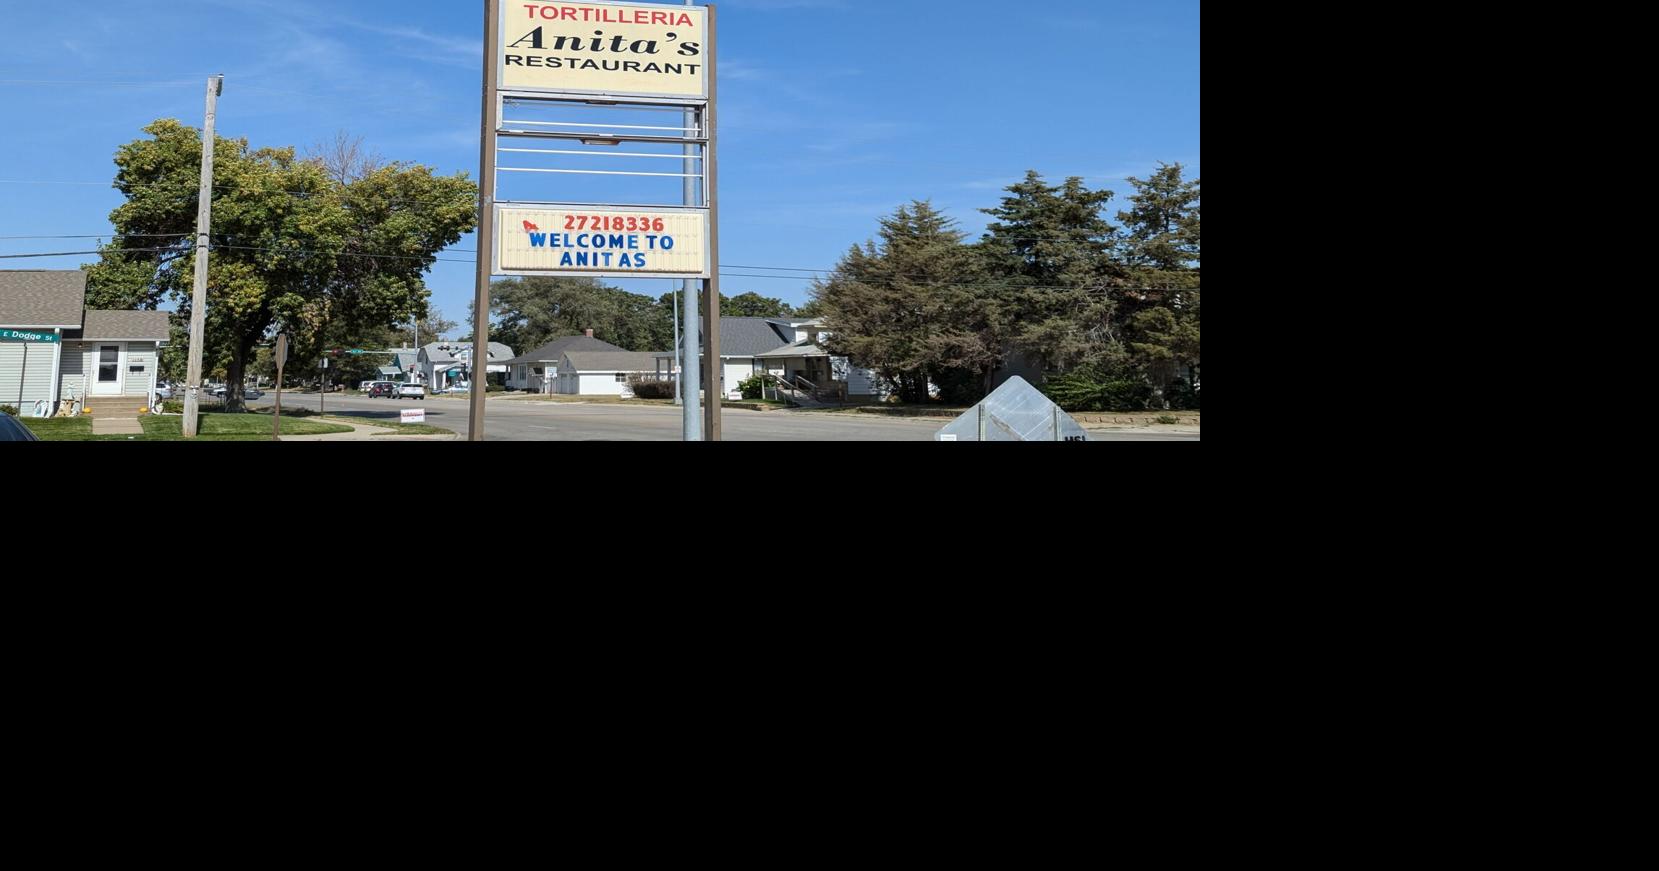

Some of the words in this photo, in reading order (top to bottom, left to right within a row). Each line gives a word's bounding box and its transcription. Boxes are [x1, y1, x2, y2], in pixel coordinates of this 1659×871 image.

[523, 5, 693, 26] TORTILLERIA
[507, 26, 700, 56] Anita's
[505, 55, 701, 75] RESTAURANT
[564, 215, 664, 232] 27218336
[529, 233, 639, 249] WELCOME
[646, 235, 674, 250] TO
[12, 331, 41, 340] Dodge
